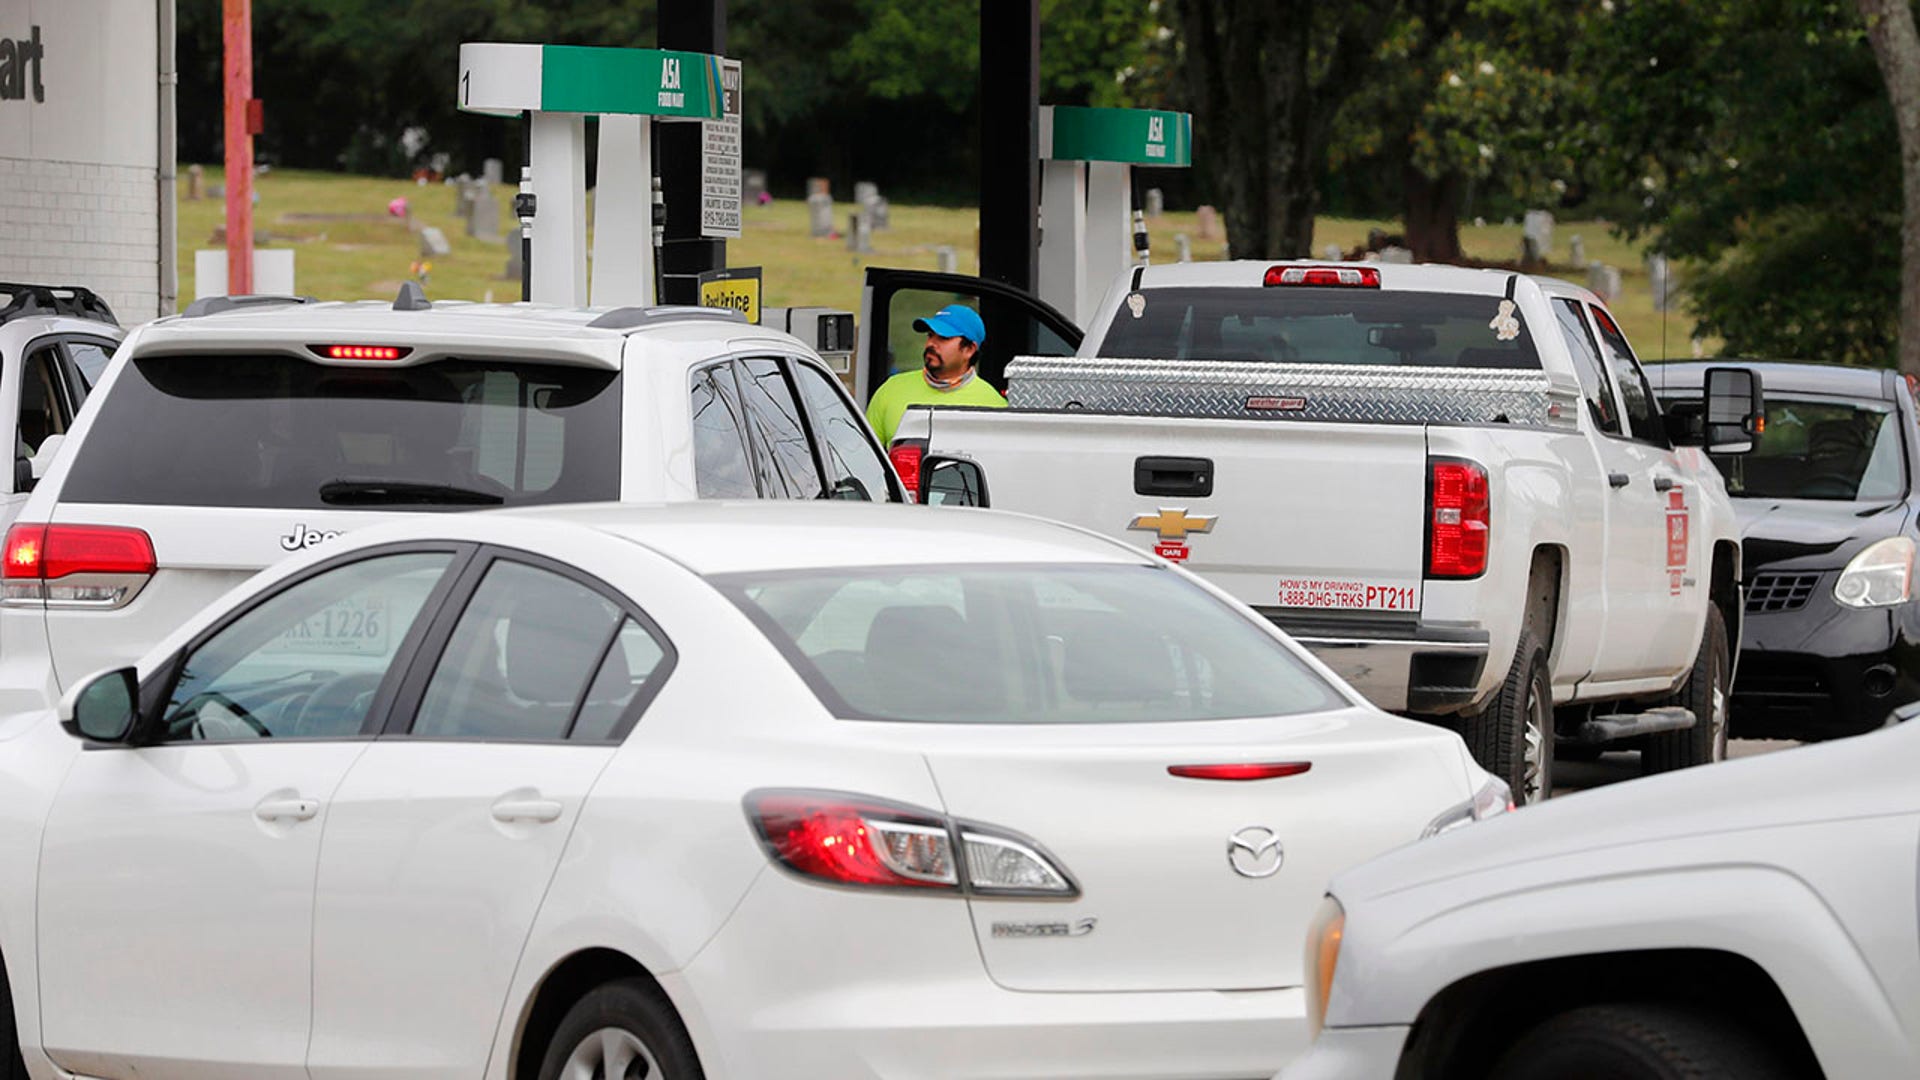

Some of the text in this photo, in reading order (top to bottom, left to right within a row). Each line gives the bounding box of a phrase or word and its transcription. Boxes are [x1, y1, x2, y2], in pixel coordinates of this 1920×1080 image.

[661, 58, 680, 89] ASA
[462, 70, 470, 106] 1
[1148, 116, 1163, 142] ASA
[720, 291, 750, 312] Price
[280, 523, 347, 552] Jee
[1280, 580, 1363, 592] HOW'S MY DRIVING?
[1366, 586, 1415, 610] PT211
[1278, 591, 1364, 608] 1-888-DHG-TRKS
